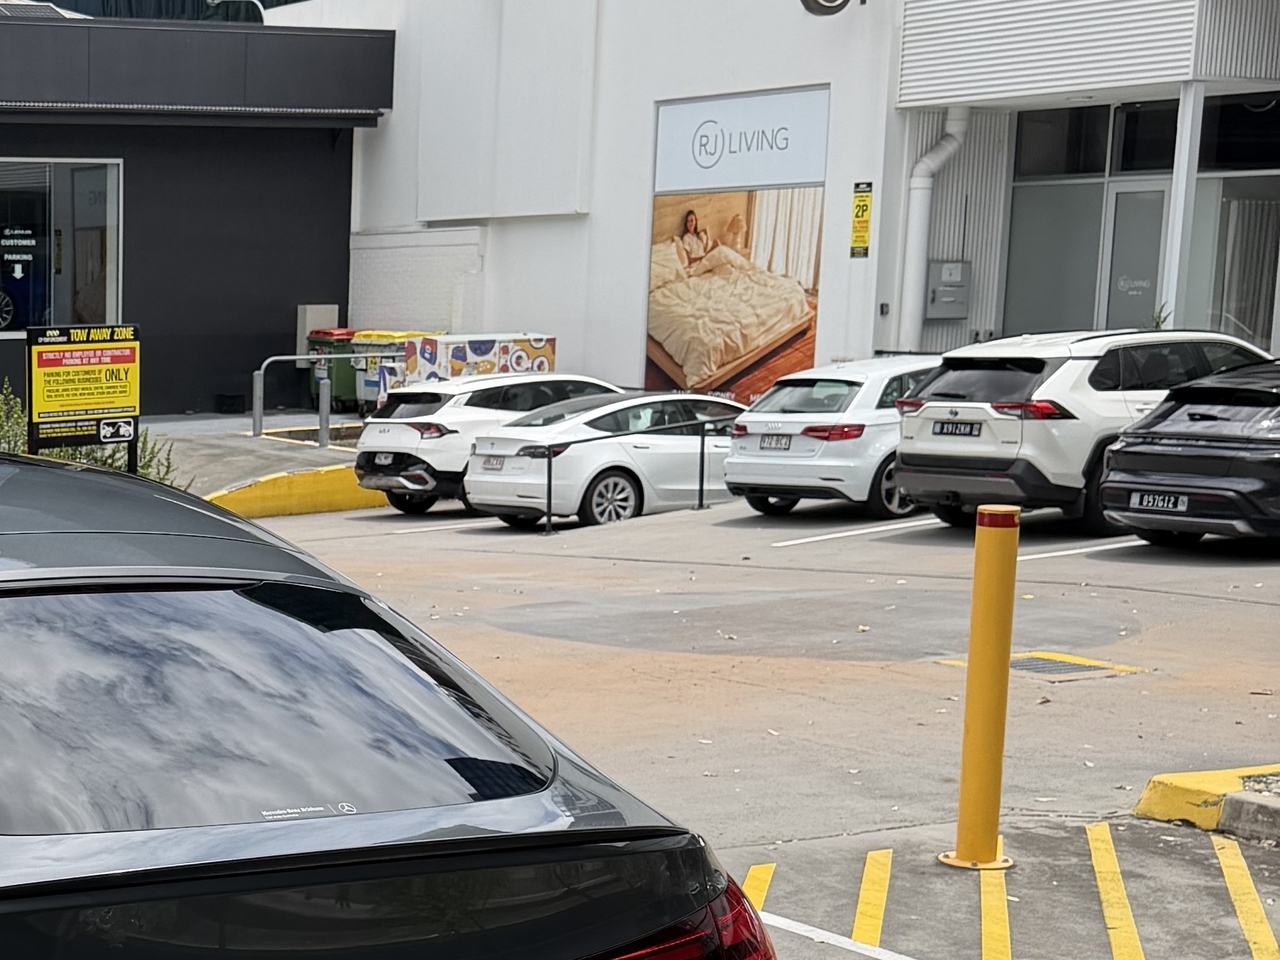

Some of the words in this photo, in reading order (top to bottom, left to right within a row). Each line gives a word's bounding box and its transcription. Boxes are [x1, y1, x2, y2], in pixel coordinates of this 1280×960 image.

[698, 134, 719, 156] RJ
[728, 127, 789, 154] LIVING
[854, 204, 869, 219] 2P
[69, 329, 88, 342] TOW
[89, 328, 112, 341] AWAY
[113, 327, 134, 340] ZONE
[105, 368, 130, 382] ONLY
